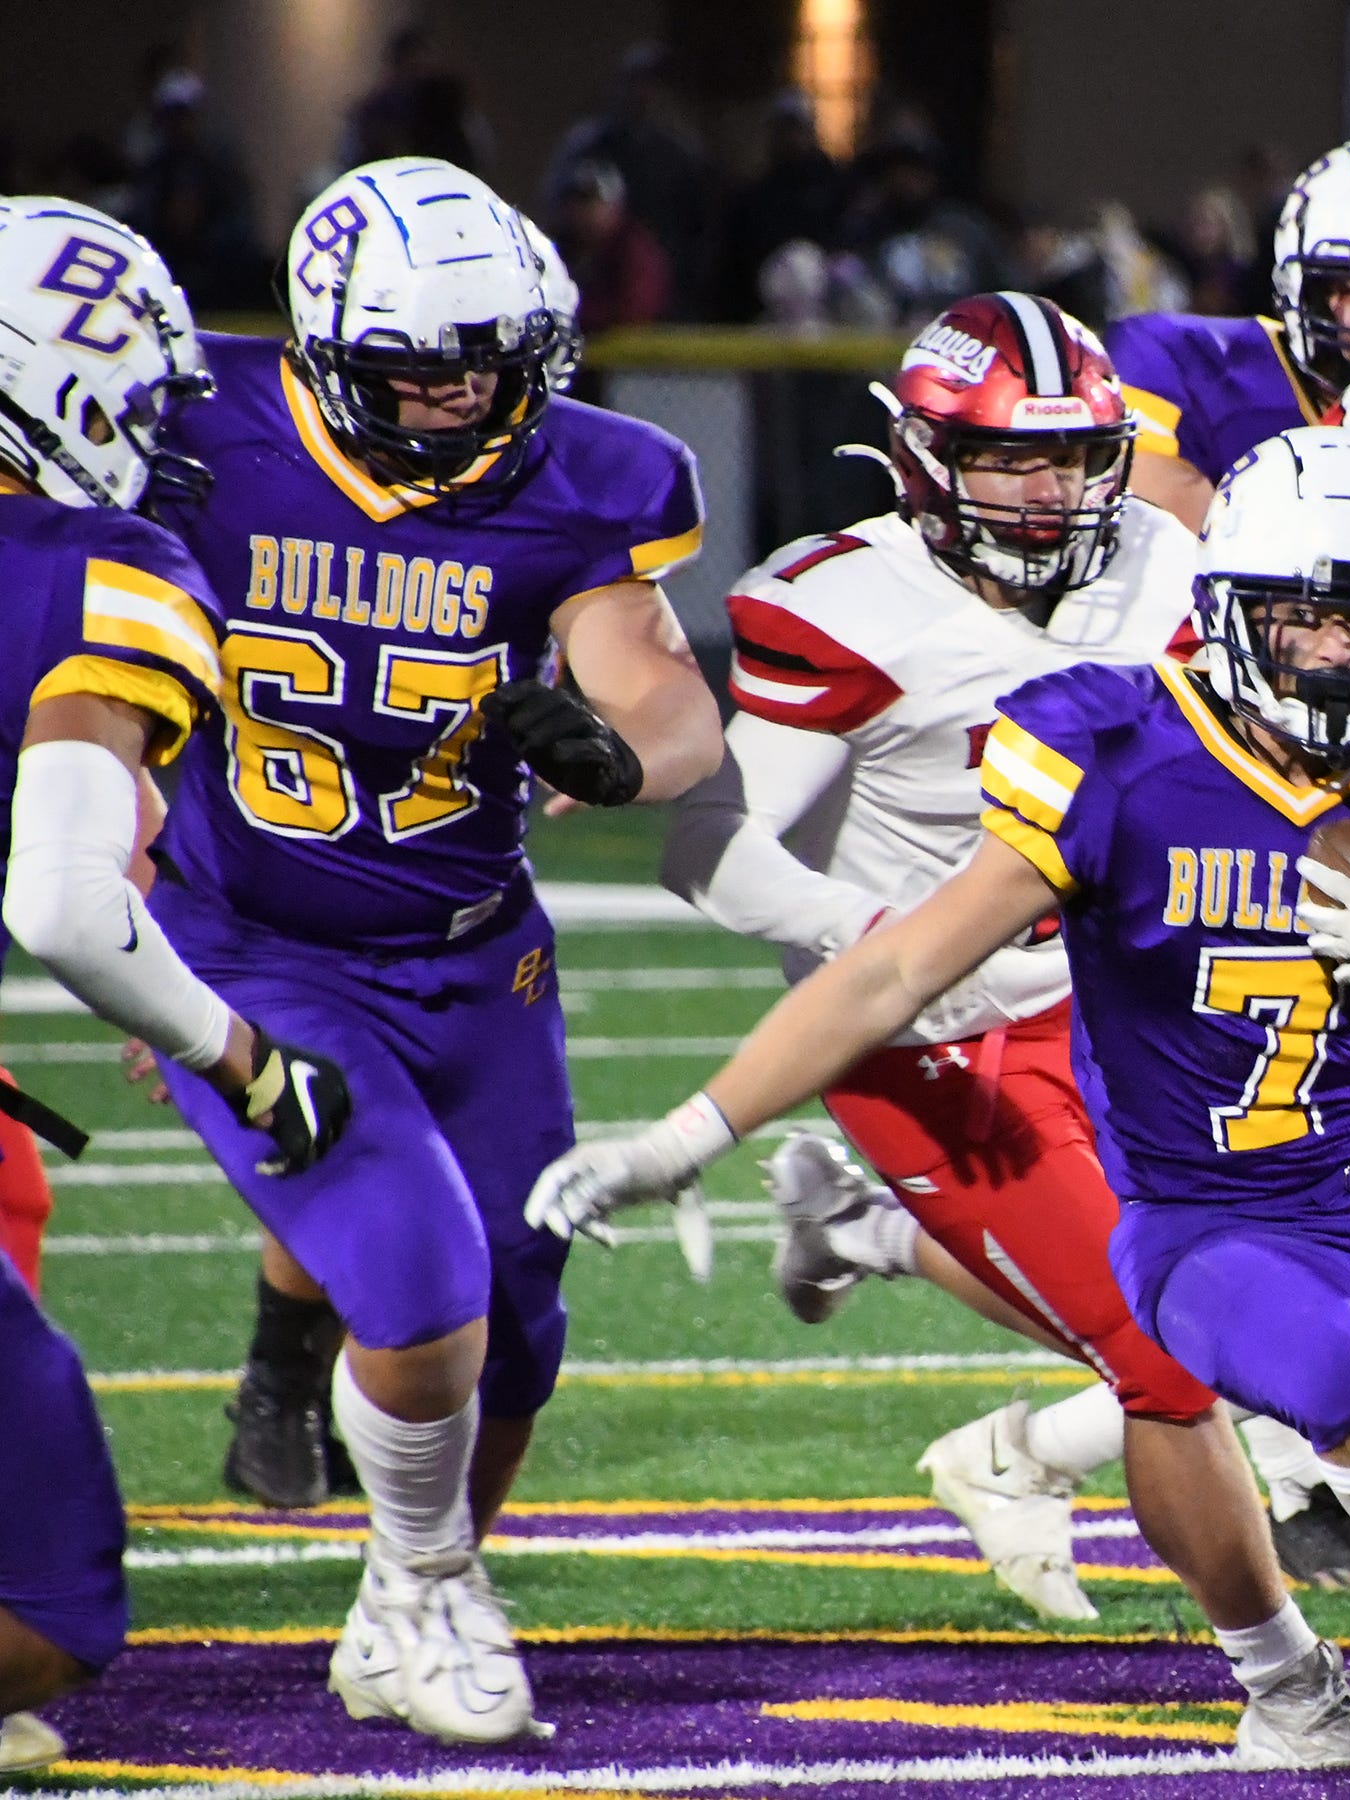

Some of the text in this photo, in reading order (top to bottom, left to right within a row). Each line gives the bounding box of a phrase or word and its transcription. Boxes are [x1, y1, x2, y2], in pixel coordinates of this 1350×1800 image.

[246, 534, 493, 639] BULLDOGS
[221, 618, 510, 844] 67
[1163, 846, 1317, 934] BULL
[1192, 946, 1345, 1153] 7
